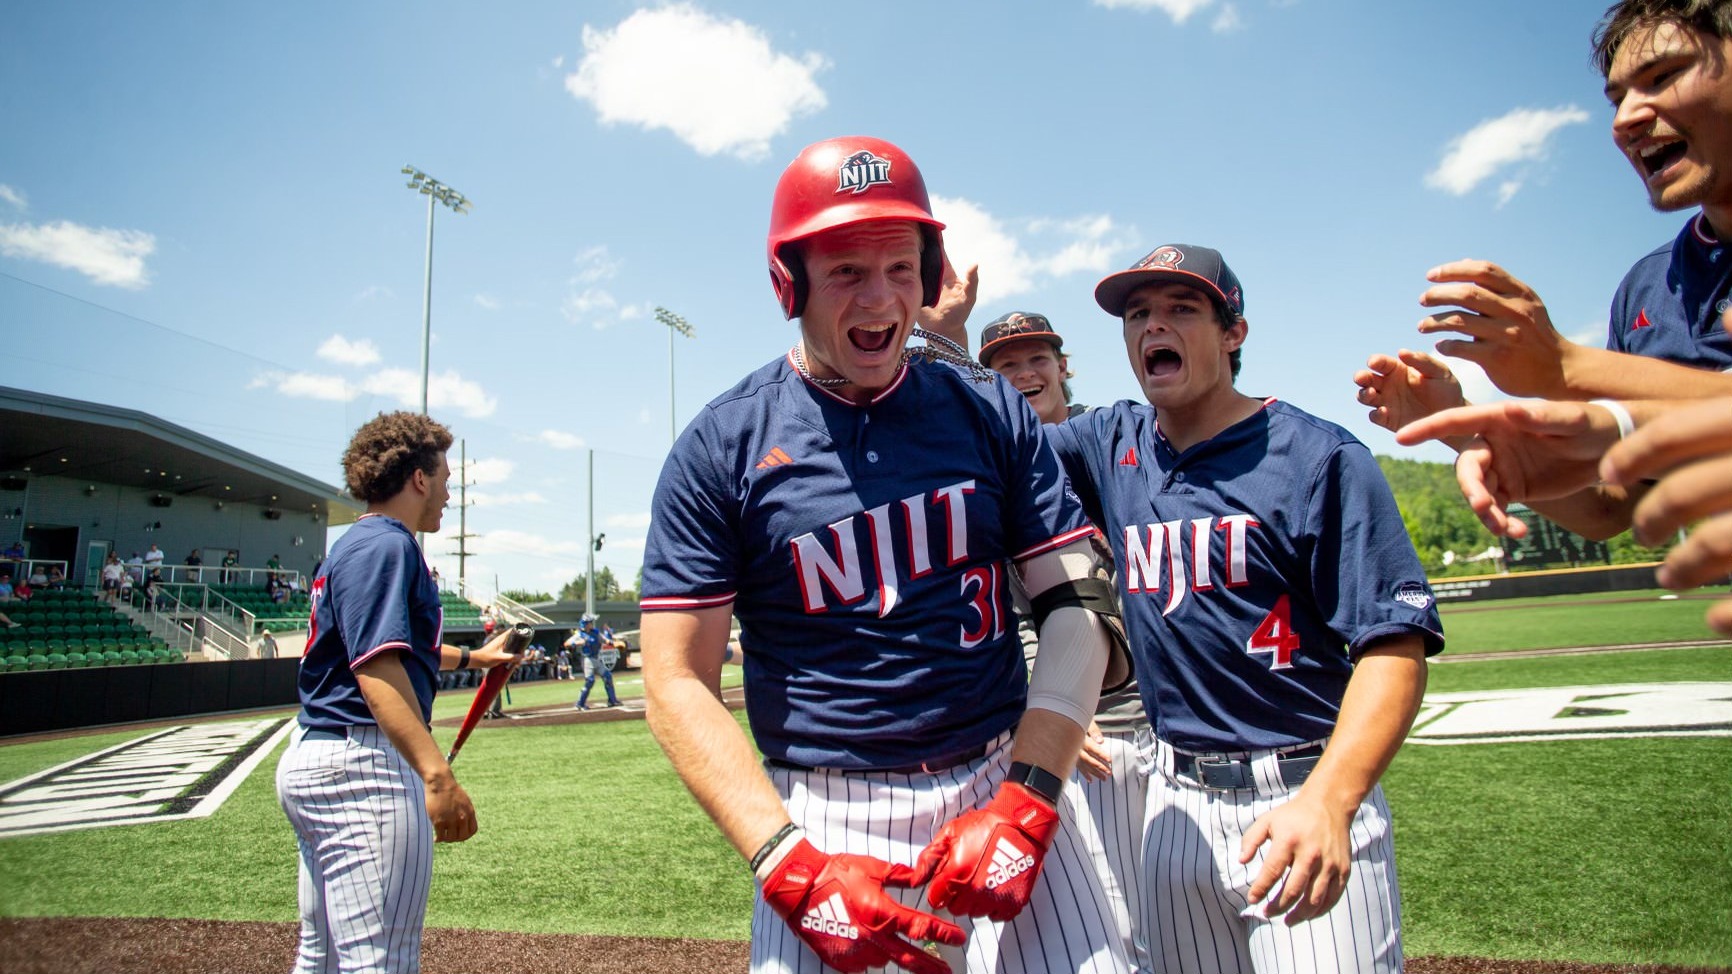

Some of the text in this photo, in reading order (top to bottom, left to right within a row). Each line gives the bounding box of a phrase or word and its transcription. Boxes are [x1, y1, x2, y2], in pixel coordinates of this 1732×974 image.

[841, 163, 888, 190] NJIT
[790, 479, 976, 618] NJIT
[1125, 513, 1261, 617] NJIT
[960, 562, 1005, 648] 31
[1247, 594, 1300, 670] 4
[985, 854, 1035, 889] adidas
[801, 915, 859, 940] adidas
